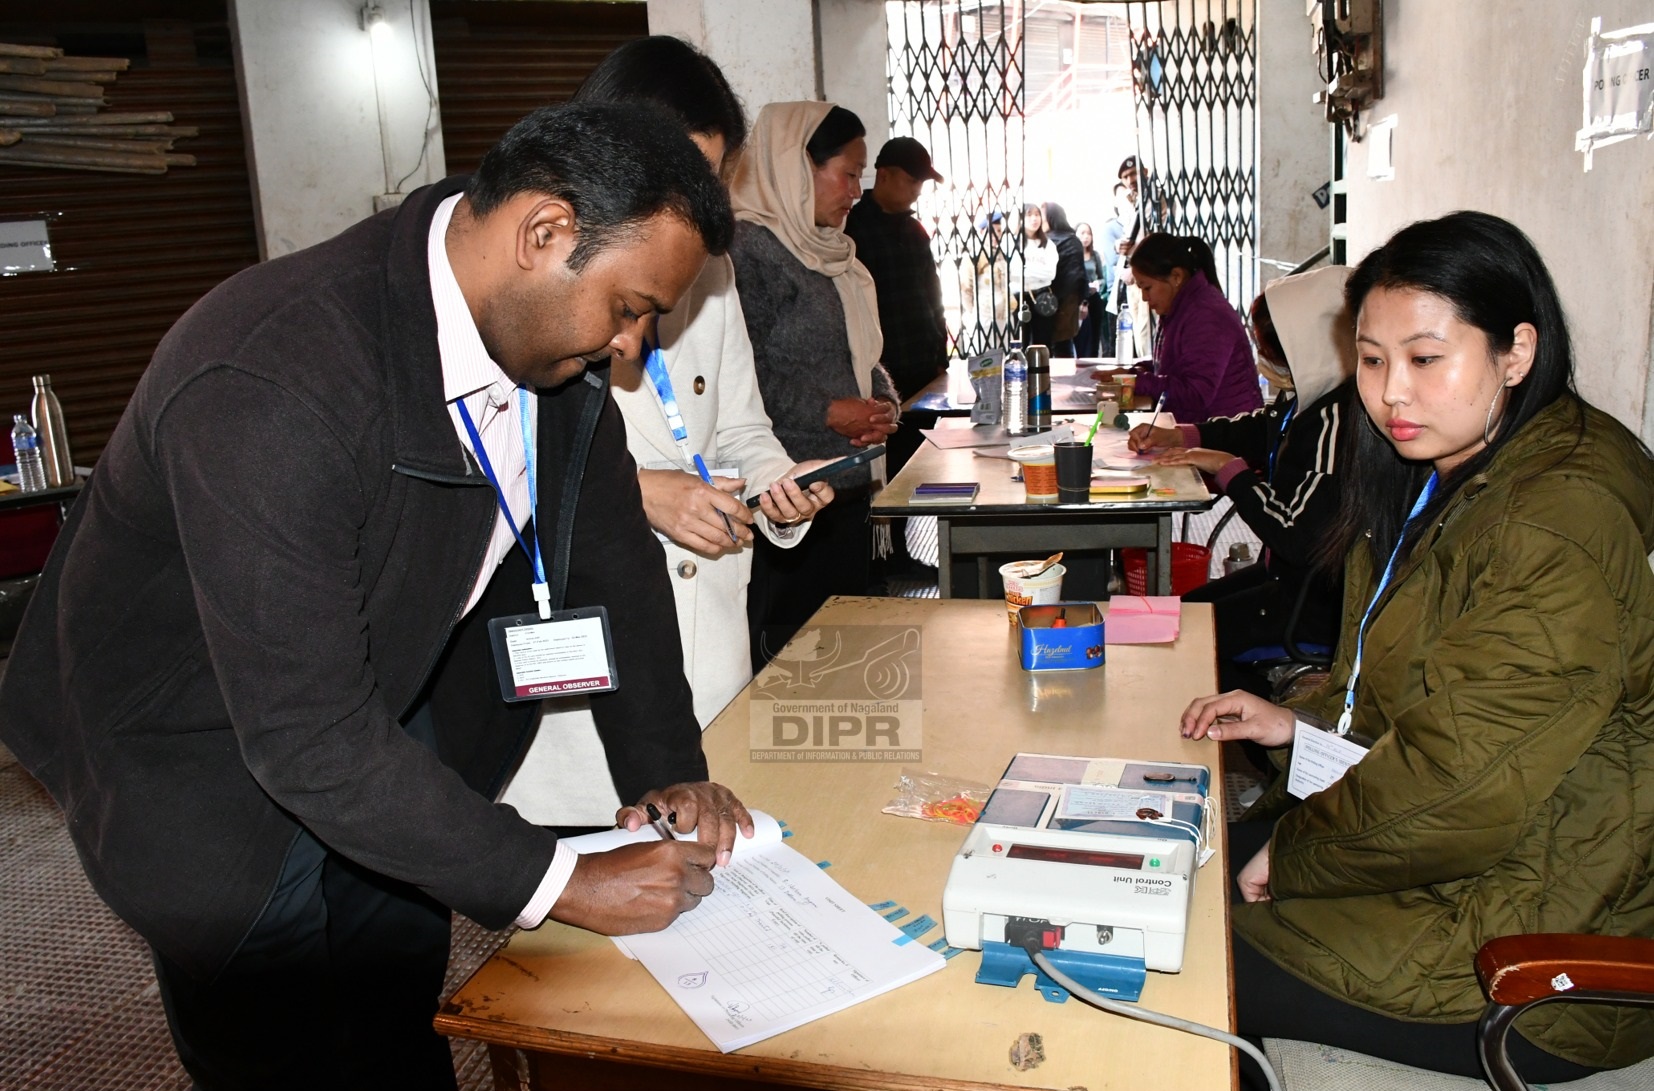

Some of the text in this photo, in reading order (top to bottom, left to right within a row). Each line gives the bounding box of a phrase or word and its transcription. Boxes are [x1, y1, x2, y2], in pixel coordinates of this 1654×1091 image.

[529, 680, 601, 693] GENERAL OBSERVER
[1113, 876, 1172, 887] Control Unit
